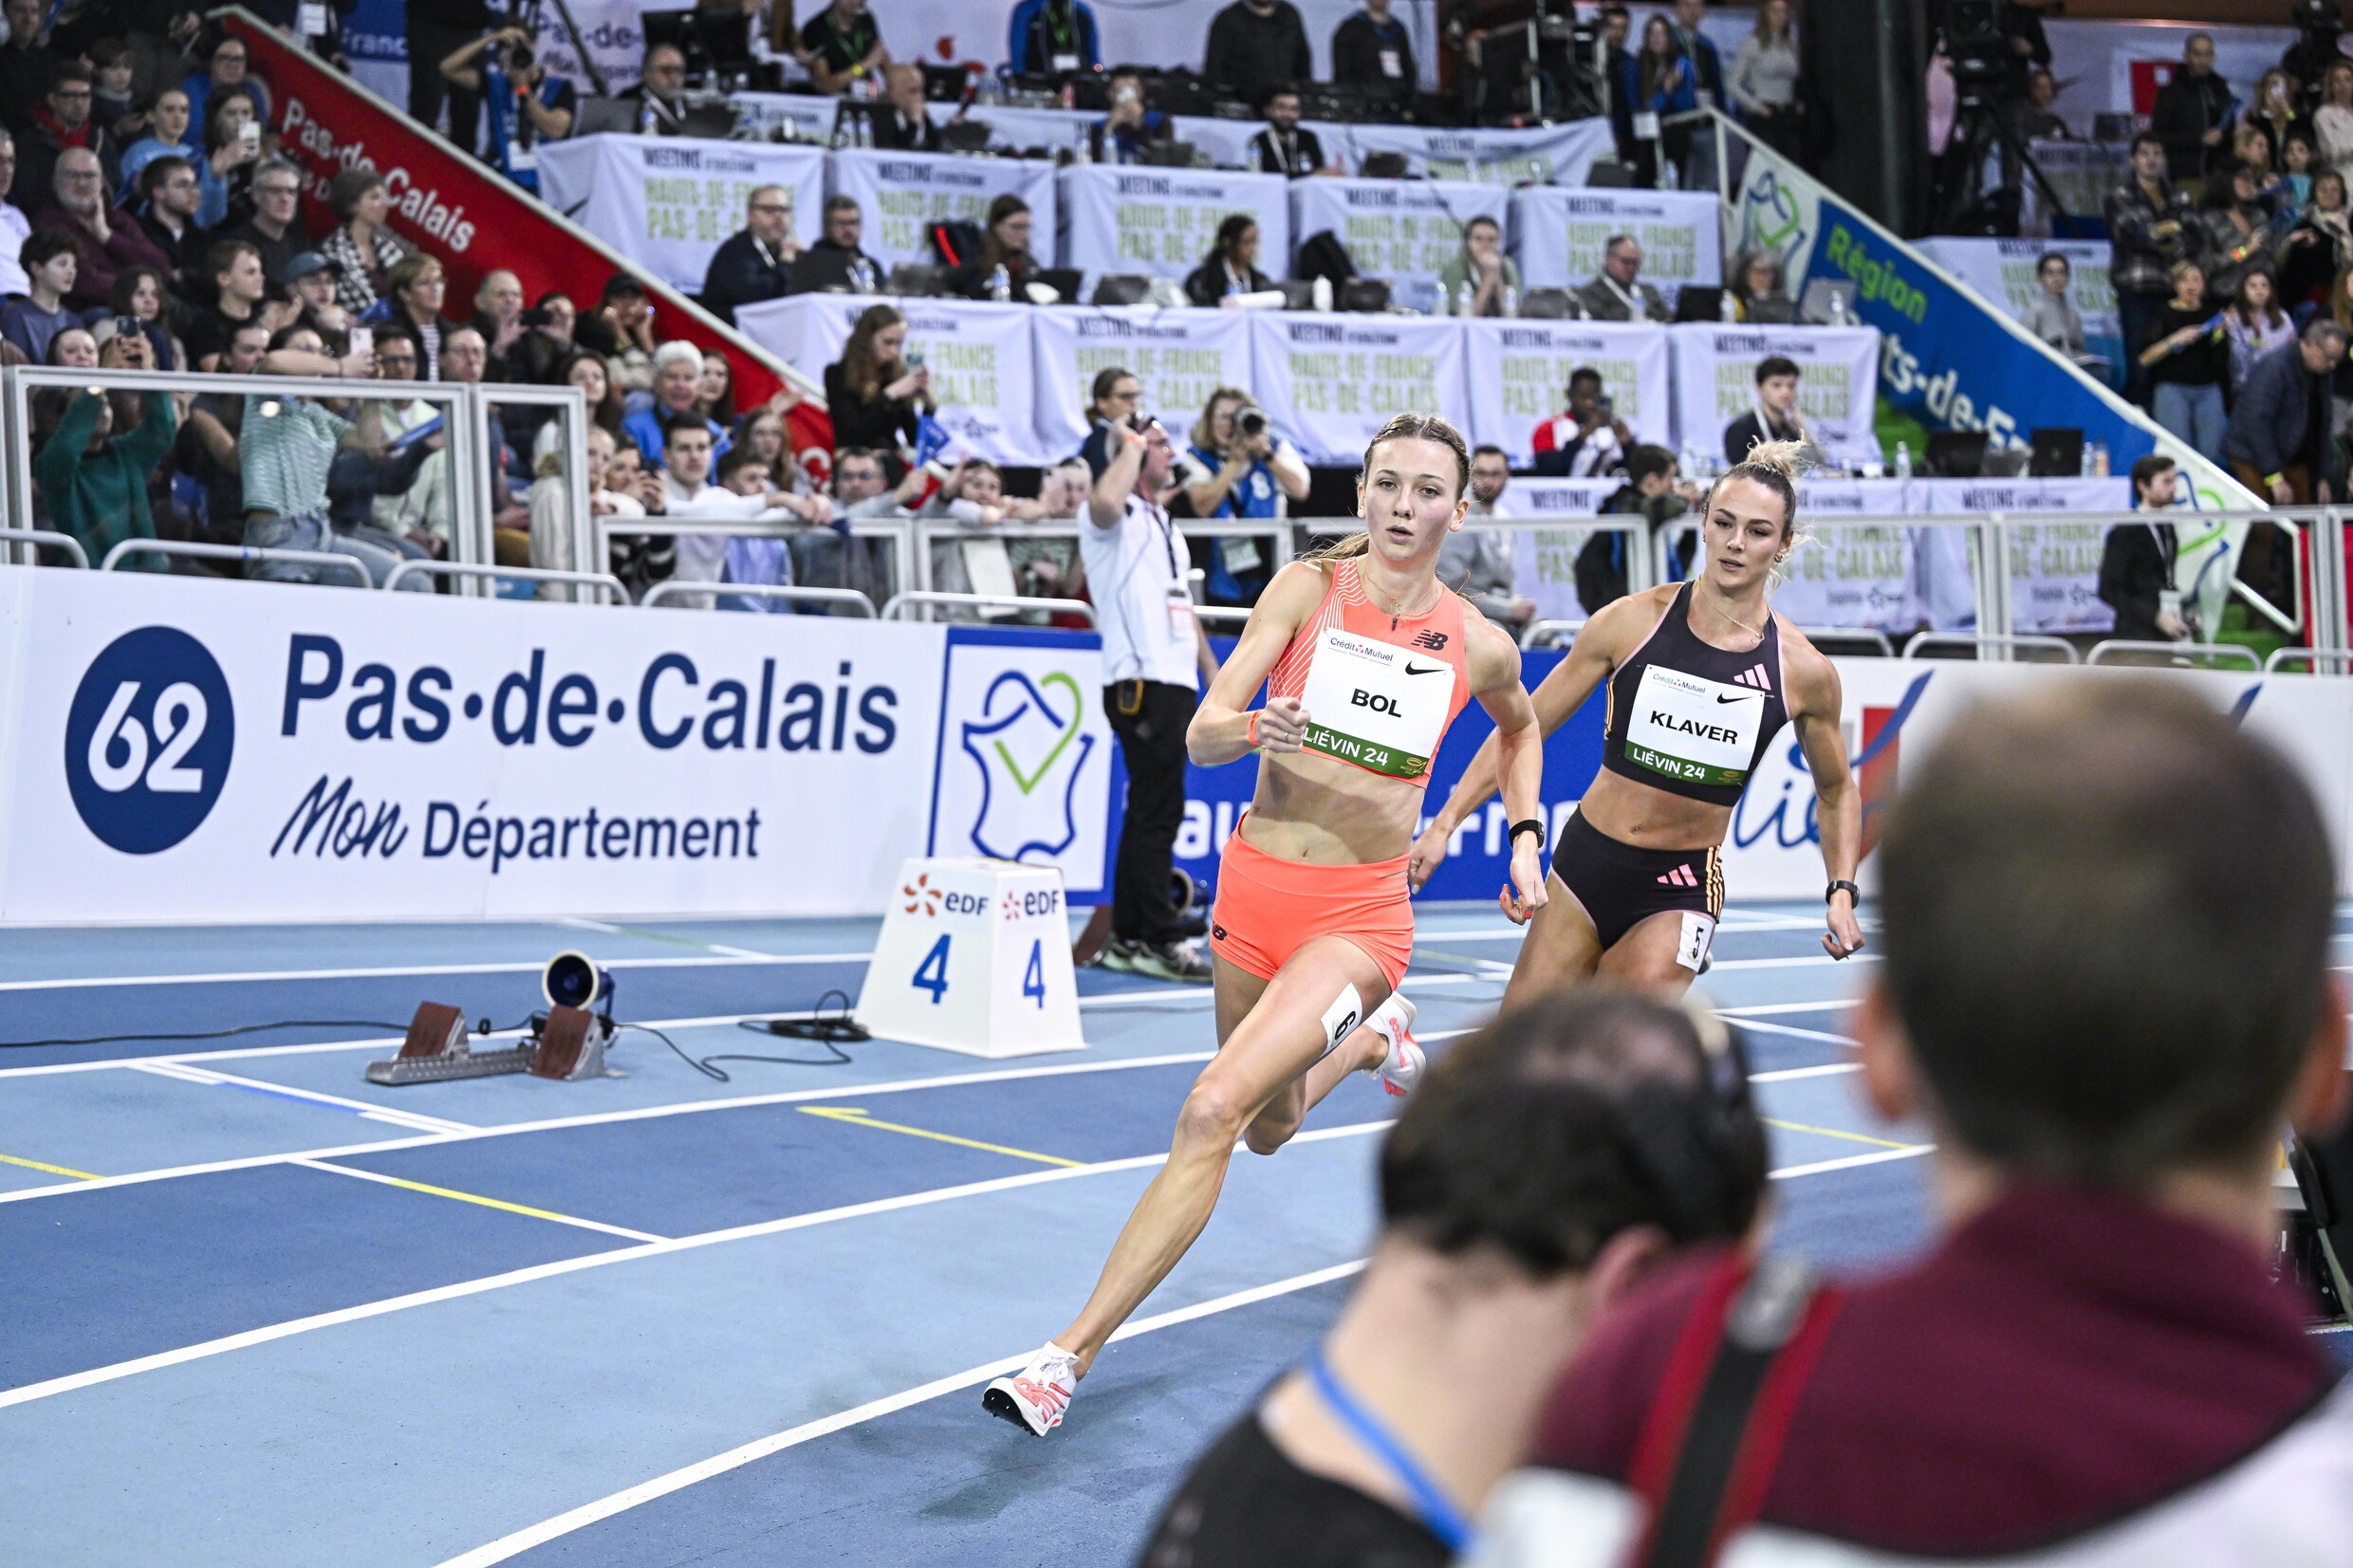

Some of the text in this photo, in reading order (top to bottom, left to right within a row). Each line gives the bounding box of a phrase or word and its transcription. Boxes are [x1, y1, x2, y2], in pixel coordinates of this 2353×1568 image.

[1827, 223, 1928, 325] Région
[1531, 489, 1590, 510] MEETING
[1961, 489, 2014, 509] MEETING
[1329, 636, 1356, 652] Crédit
[1364, 647, 1394, 662] Mutuel
[1350, 688, 1402, 719] BOL
[1681, 681, 1707, 693] Mutuel
[87, 680, 203, 794] 62
[1649, 710, 1738, 746] KLAVER
[1304, 727, 1389, 767] LIÉVIN 24
[1633, 747, 1706, 781] LIÉVIN 24
[269, 773, 763, 875] Mon Département
[1692, 926, 1705, 959] 5
[911, 932, 952, 1005] 4
[1023, 938, 1047, 1010] 4
[1334, 1010, 1357, 1041] 6
